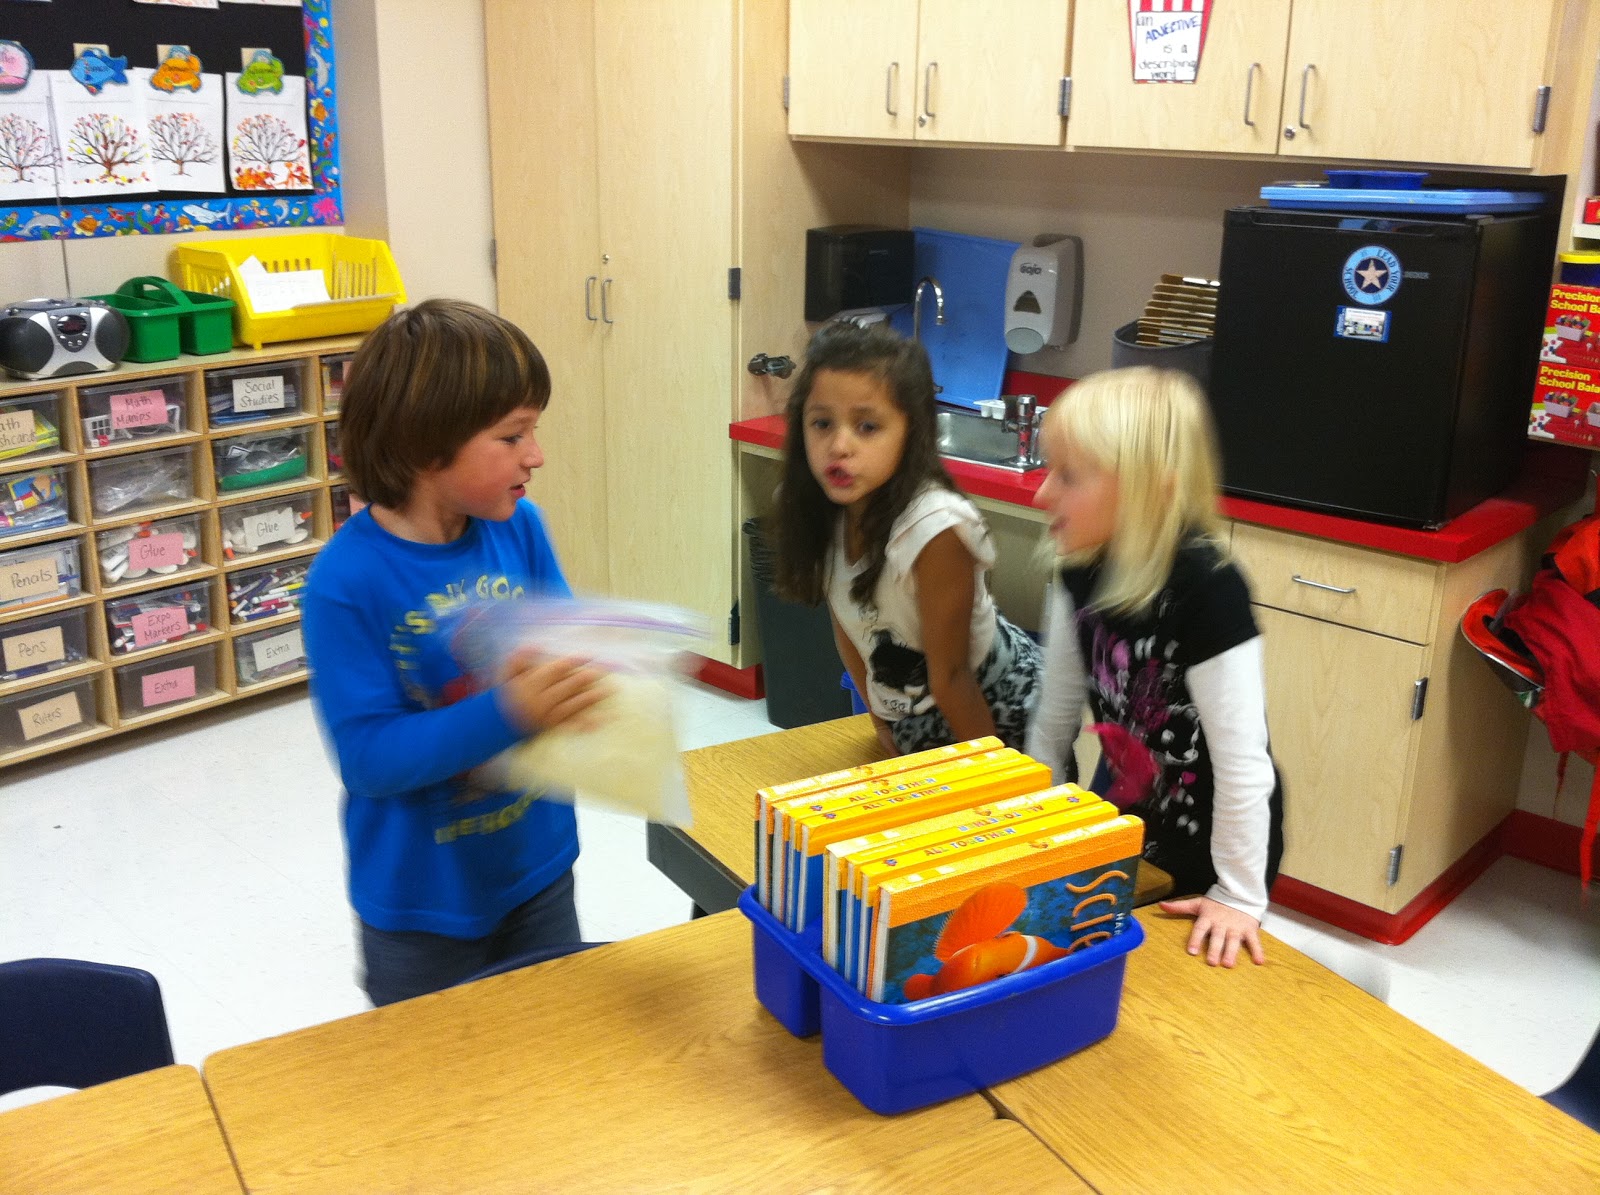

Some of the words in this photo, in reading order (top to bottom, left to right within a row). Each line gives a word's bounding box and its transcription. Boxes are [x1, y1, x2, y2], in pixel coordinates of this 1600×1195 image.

[1145, 15, 1200, 44] ADJECTIVE
[1376, 249, 1396, 268] LEAD
[1344, 267, 1359, 298] SCHOOL
[1387, 270, 1399, 293] YOUR
[1550, 300, 1588, 312] School
[1540, 365, 1591, 381] Precision
[244, 380, 276, 394] Social
[1539, 376, 1576, 390] School
[124, 395, 153, 410] Math
[239, 392, 280, 408] Studies
[116, 410, 151, 427] Manips
[256, 521, 279, 535] Glue
[139, 543, 166, 560] Glue
[147, 612, 171, 627] Expo
[144, 620, 181, 640] Markers
[18, 639, 47, 656] Pens
[266, 643, 290, 658] Extra
[154, 679, 179, 694] Extra
[874, 777, 936, 796] TOGETHER
[887, 785, 951, 804] TOGETHER
[950, 827, 1016, 849] TOGETHER
